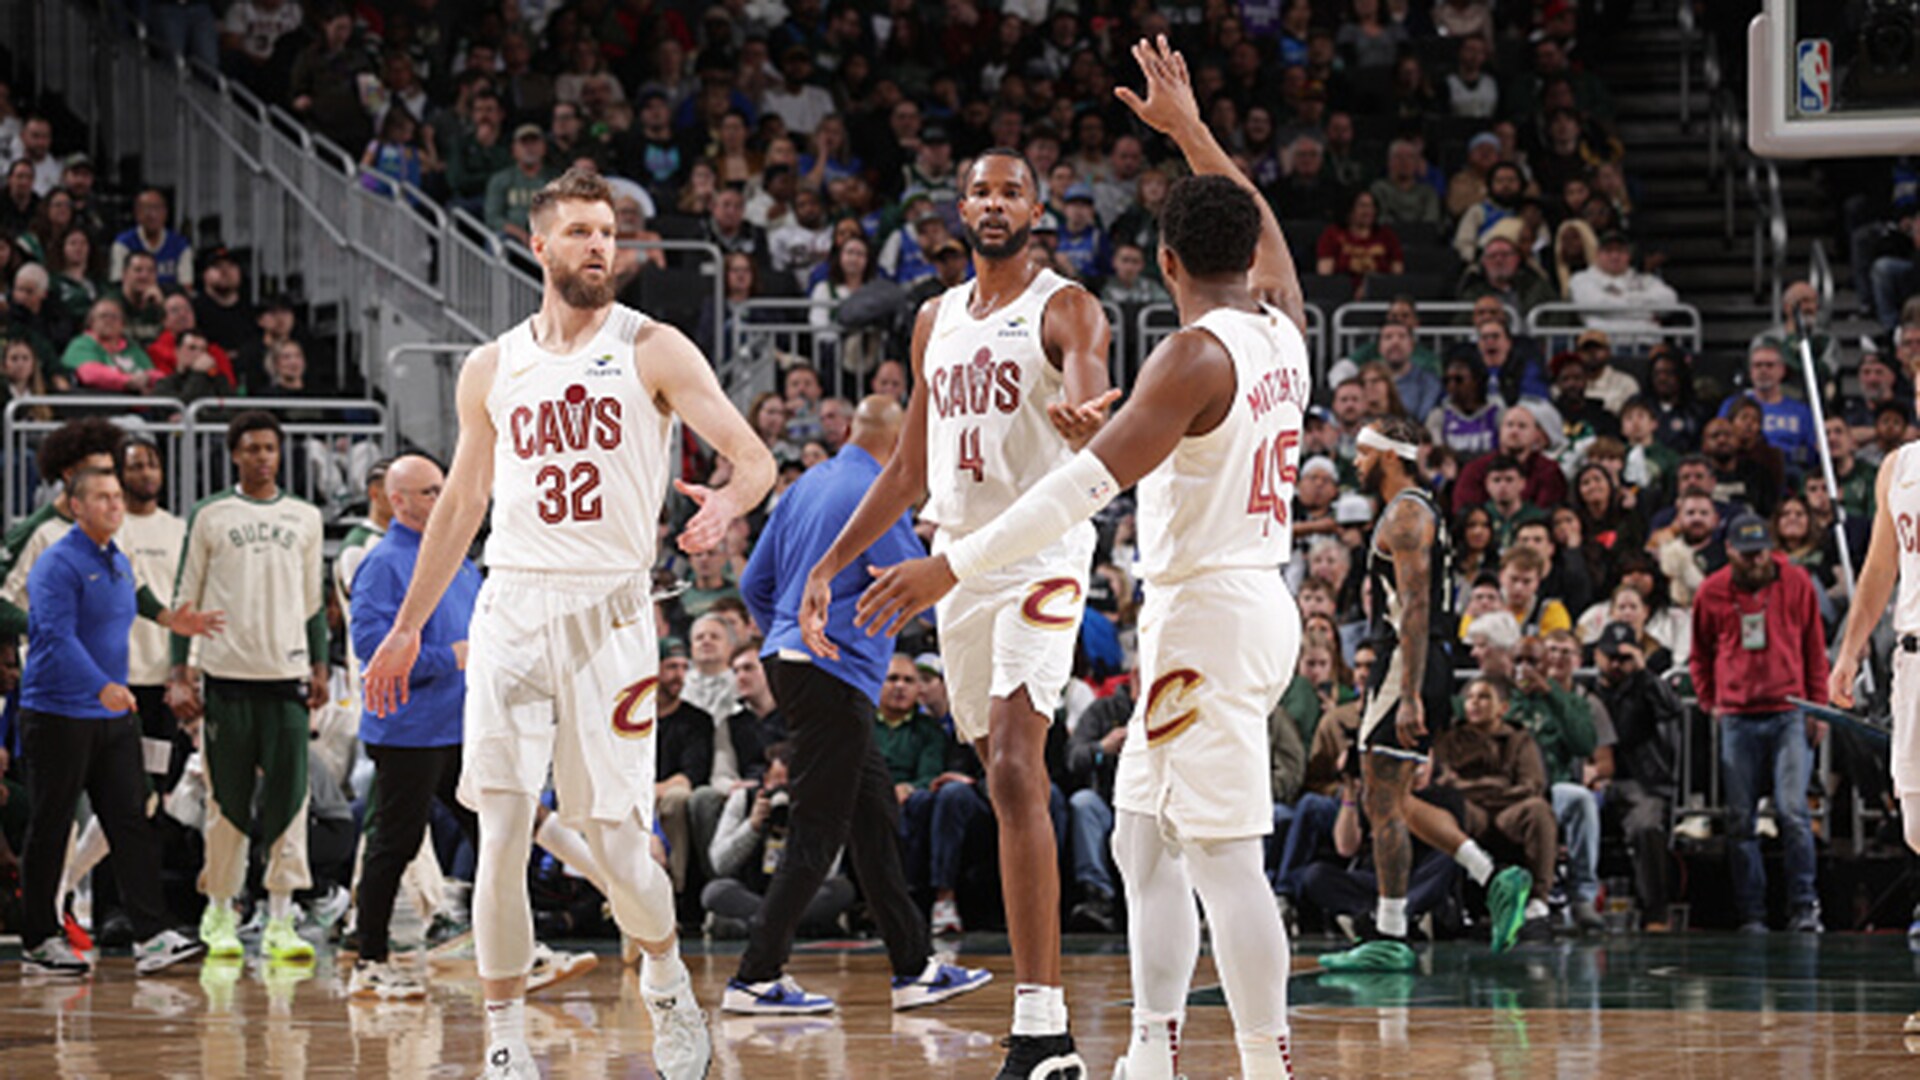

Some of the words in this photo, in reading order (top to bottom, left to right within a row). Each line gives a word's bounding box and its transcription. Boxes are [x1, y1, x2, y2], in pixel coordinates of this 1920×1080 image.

[932, 360, 1021, 420] CAVS
[510, 397, 622, 460] CAVS
[958, 426, 984, 483] 4
[536, 461, 603, 525] 32
[228, 522, 298, 551] BUCKS
